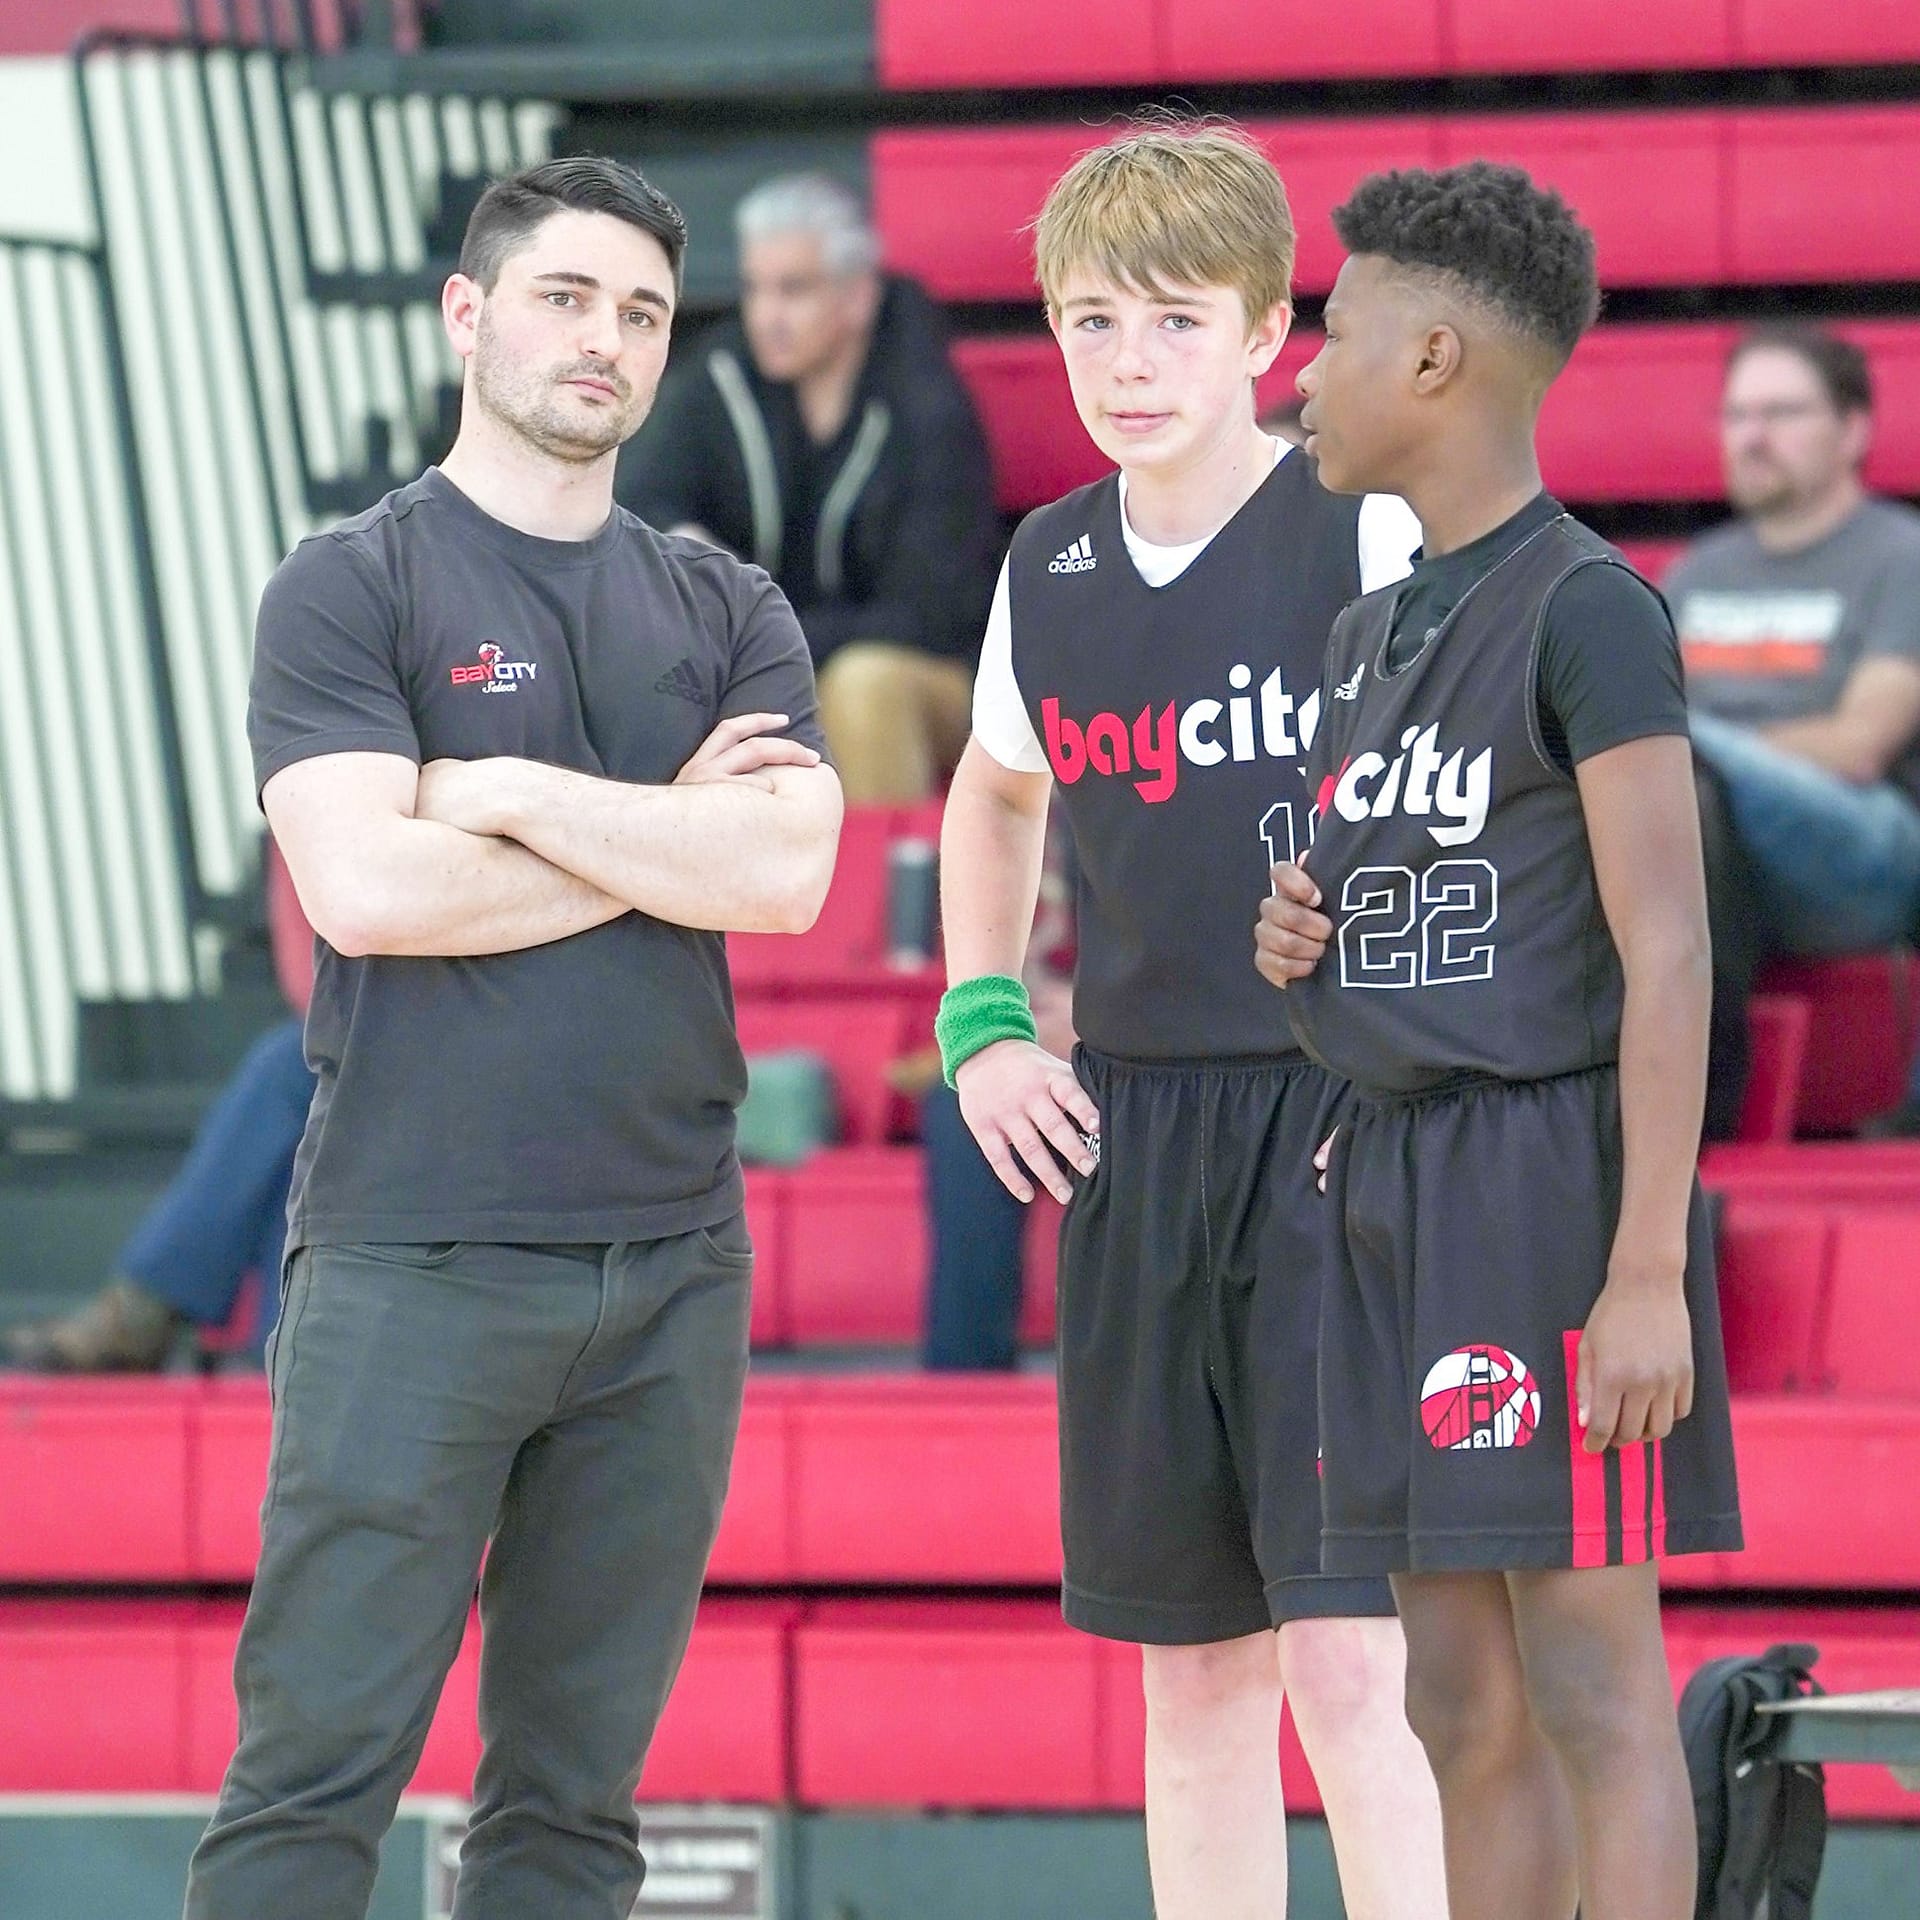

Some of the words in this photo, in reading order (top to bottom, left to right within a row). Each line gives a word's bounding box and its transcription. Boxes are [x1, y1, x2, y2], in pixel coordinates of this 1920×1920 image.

[1048, 557, 1097, 574] adidas
[482, 680, 518, 693] Select
[1259, 802, 1320, 898] 1
[1338, 859, 1498, 988] 22
